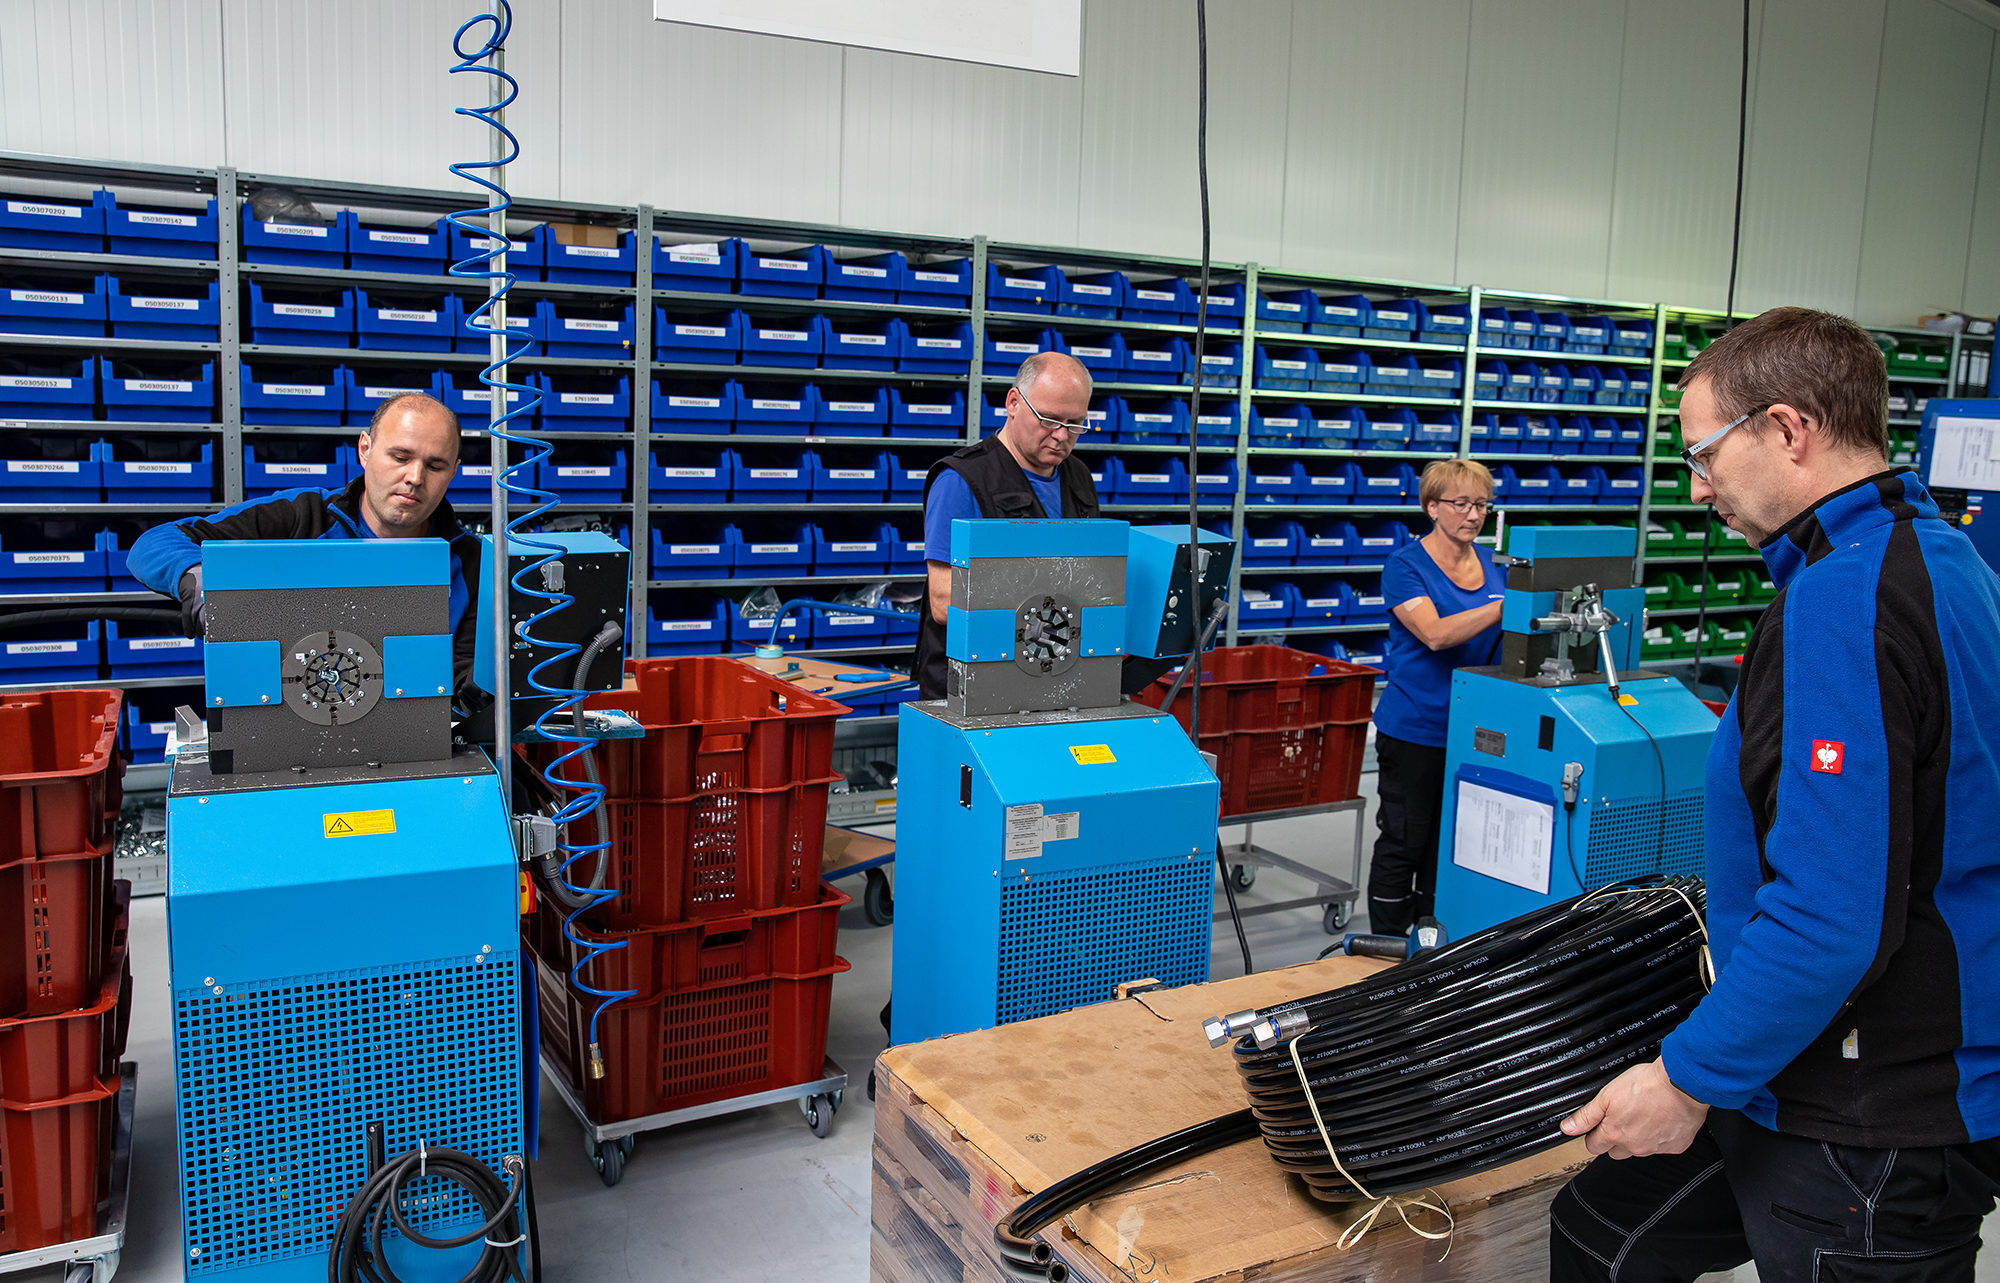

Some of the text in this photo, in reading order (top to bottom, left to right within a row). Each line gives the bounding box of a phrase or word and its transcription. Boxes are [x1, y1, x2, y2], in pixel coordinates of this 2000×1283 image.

[22, 206, 66, 216] 0503070202
[142, 216, 182, 224] 0503070142
[25, 294, 68, 302] 0503050133
